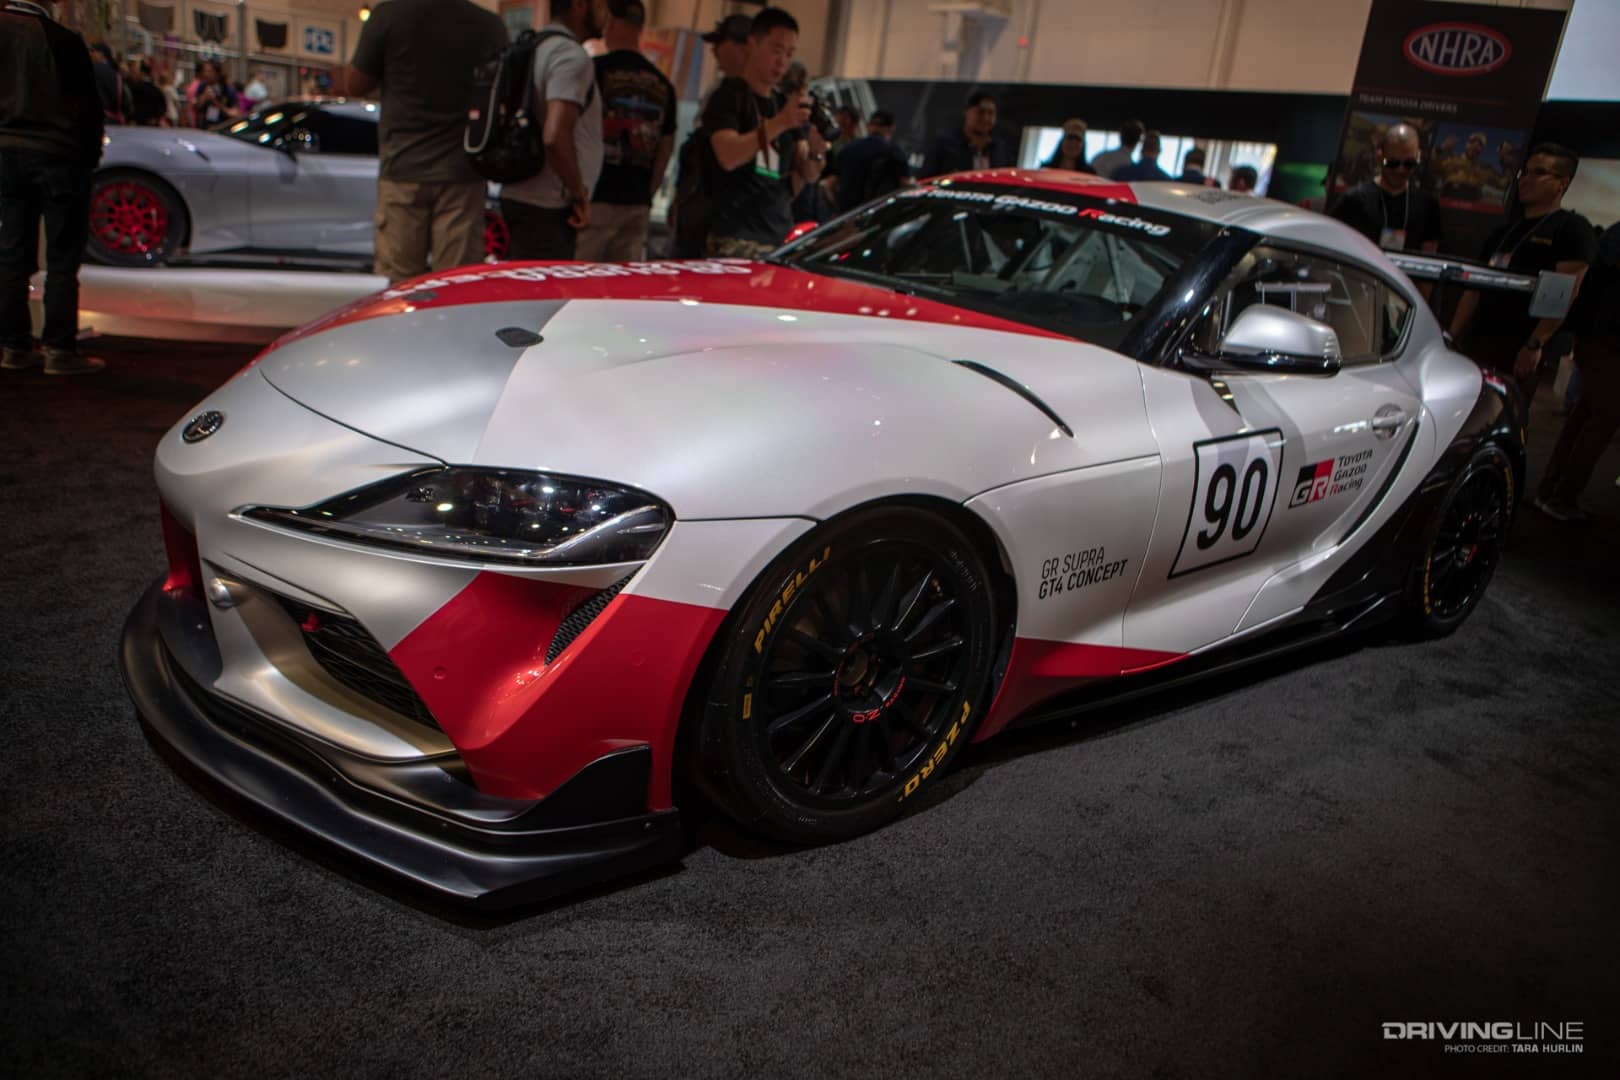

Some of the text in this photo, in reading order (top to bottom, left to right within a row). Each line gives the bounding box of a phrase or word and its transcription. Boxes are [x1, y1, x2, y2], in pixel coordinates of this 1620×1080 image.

[1417, 31, 1495, 68] NHRA
[1079, 208, 1171, 236] Racing
[1197, 456, 1268, 549] 90
[1291, 475, 1331, 505] GR
[1038, 558, 1129, 600] GT4 CONCEPT
[1041, 546, 1105, 580] GR SUPRA
[754, 545, 831, 655] PIRELLI
[904, 721, 960, 798] ZERO
